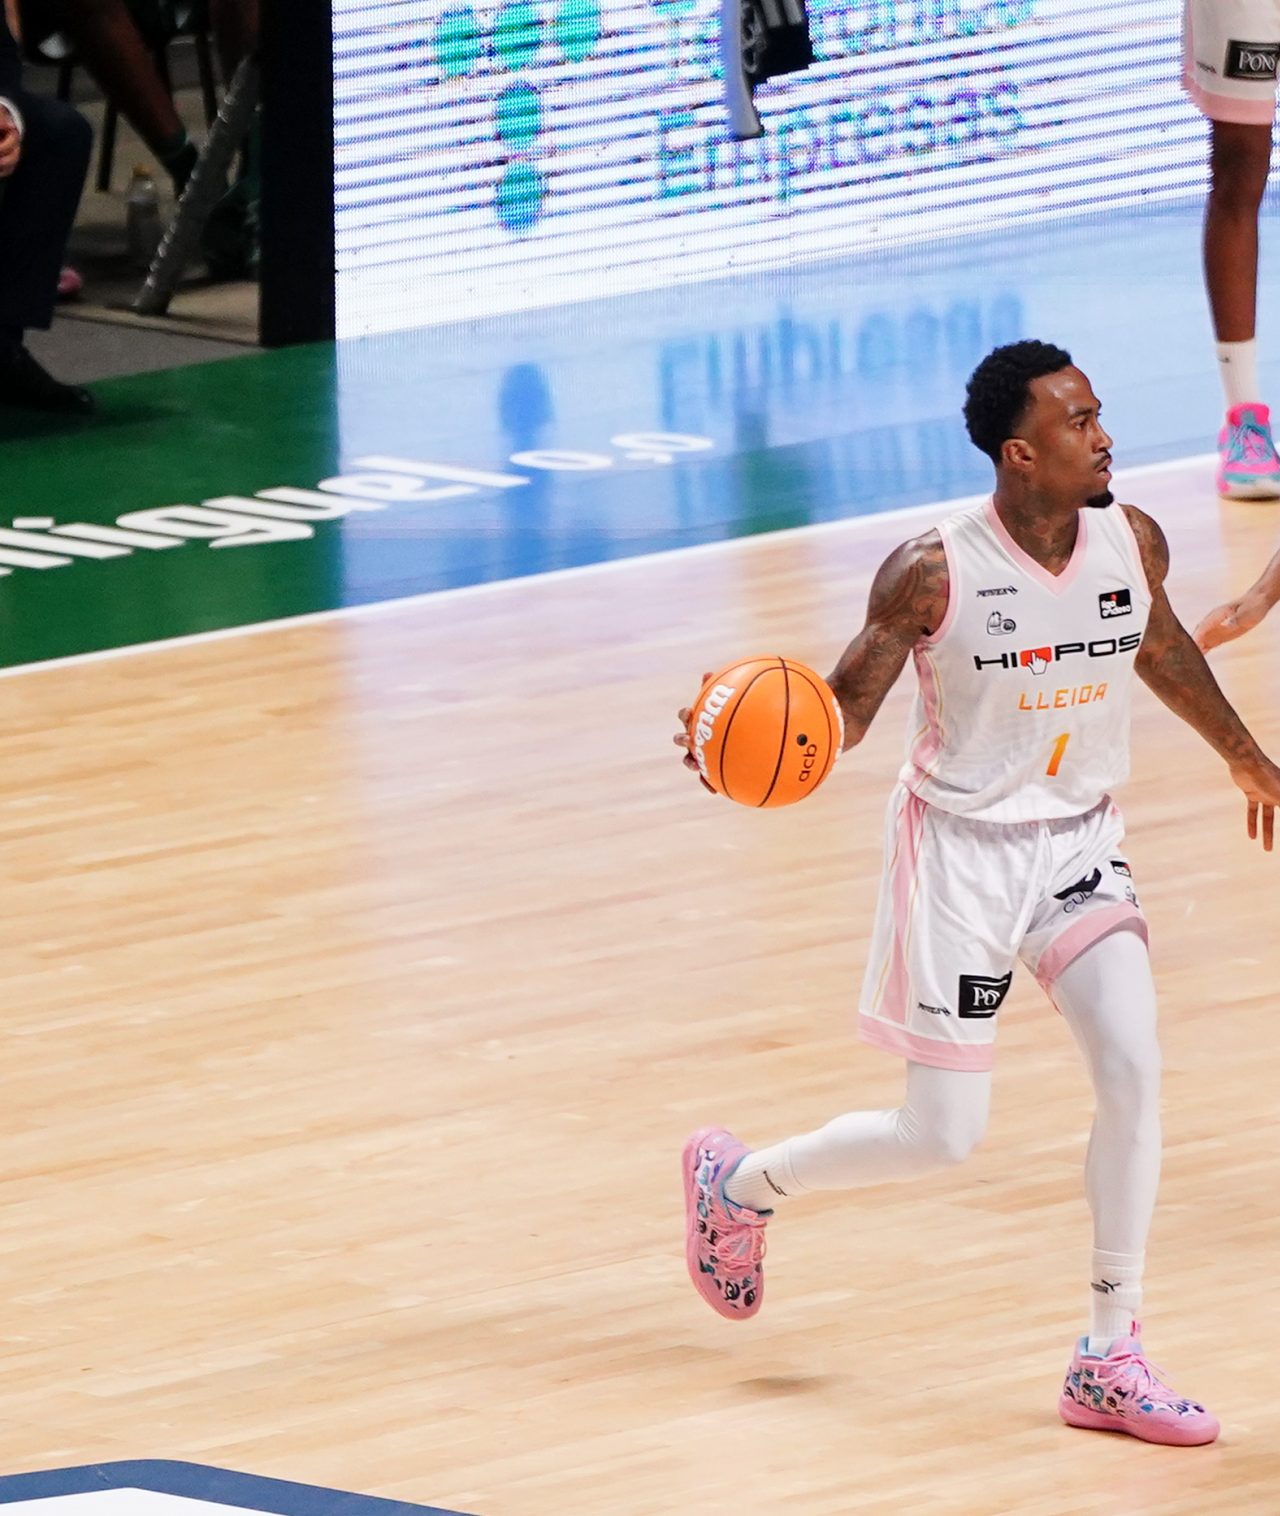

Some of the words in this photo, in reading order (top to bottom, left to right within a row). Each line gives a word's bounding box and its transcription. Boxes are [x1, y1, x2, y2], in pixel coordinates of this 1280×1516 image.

[1238, 50, 1278, 73] PON
[1018, 683, 1108, 711] LLEIDA
[798, 743, 818, 783] acb
[1046, 732, 1071, 777] 1
